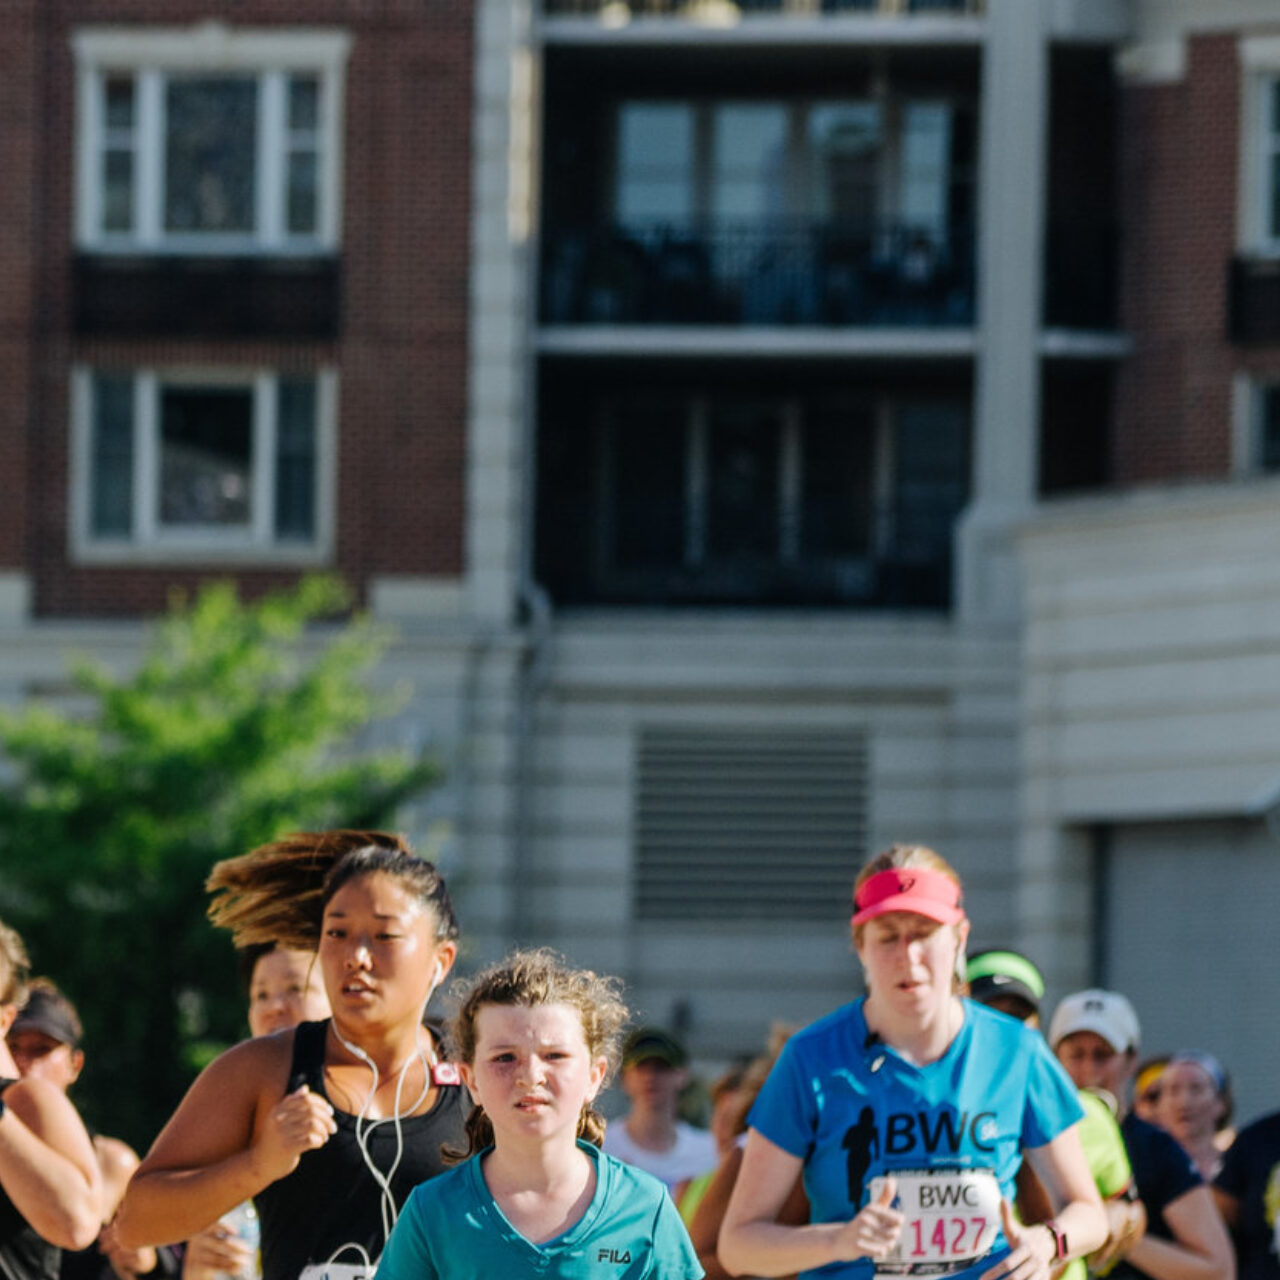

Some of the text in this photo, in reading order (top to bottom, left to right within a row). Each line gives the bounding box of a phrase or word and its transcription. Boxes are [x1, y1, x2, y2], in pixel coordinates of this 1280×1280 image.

[885, 1112, 998, 1154] BWC
[920, 1184, 979, 1208] BWC
[910, 1217, 986, 1256] 1427
[598, 1249, 631, 1264] FILA
